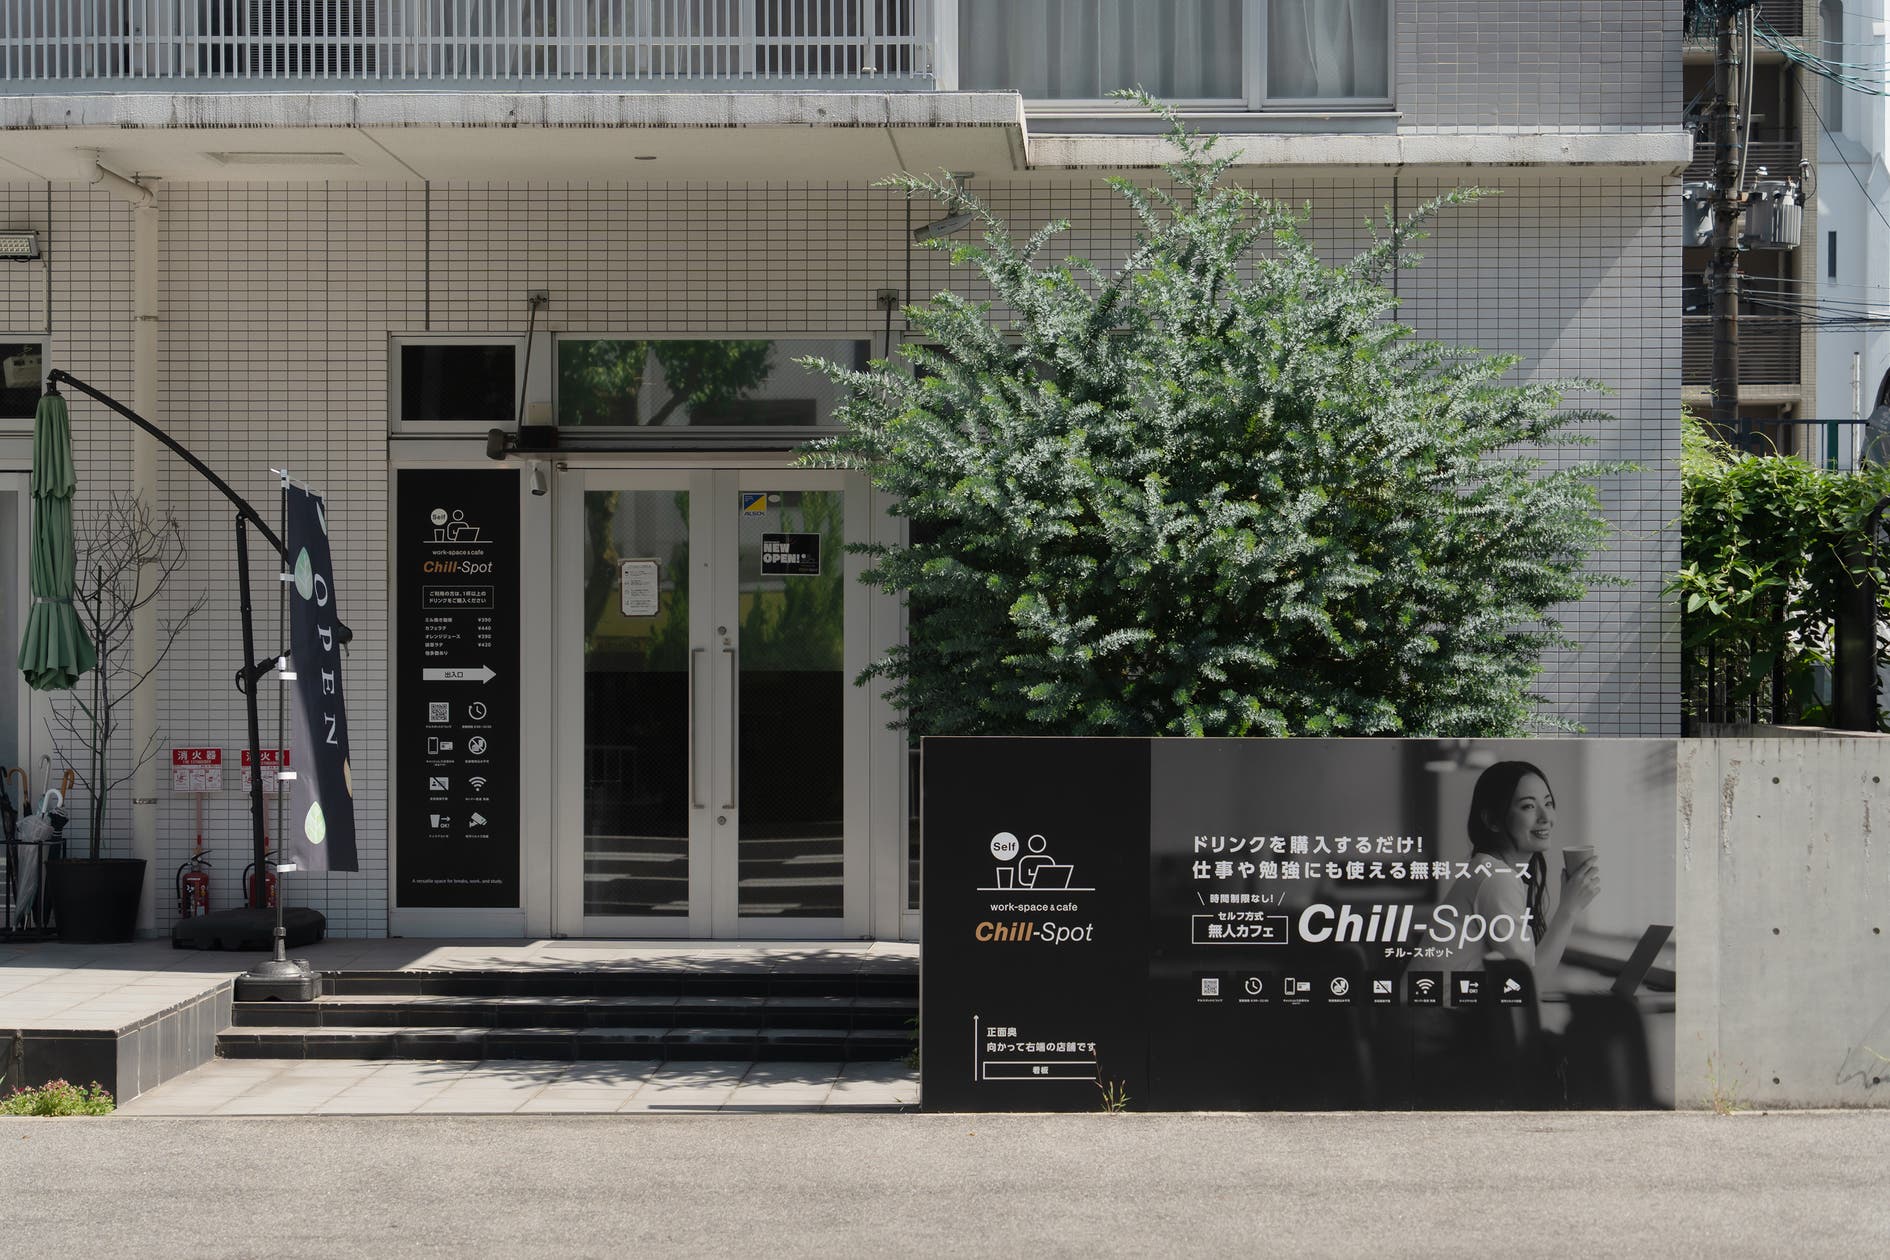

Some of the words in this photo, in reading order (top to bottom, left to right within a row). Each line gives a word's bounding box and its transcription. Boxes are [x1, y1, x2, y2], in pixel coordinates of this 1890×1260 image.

[763, 543, 790, 553] NEW
[763, 553, 800, 564] OPEN!
[423, 561, 493, 574] Chill-Spot
[314, 573, 338, 746] OPEN
[444, 671, 464, 679] 出入口
[178, 750, 216, 760] 消火器
[993, 842, 1016, 851] Self
[1193, 860, 1532, 881] 仕事や勉強にも使える無料スペース
[990, 903, 1049, 912] work-space
[1056, 902, 1078, 911] cafe
[1218, 911, 1264, 921] セルフ方式
[1208, 924, 1274, 938] 無人カフェ
[1298, 903, 1534, 950] Chill-Spot
[975, 921, 1094, 945] Chill-Spot
[987, 1027, 1017, 1037] 正面奥
[987, 1042, 1096, 1053] 向かって右端の店舗です
[1032, 1066, 1049, 1074] 看板
